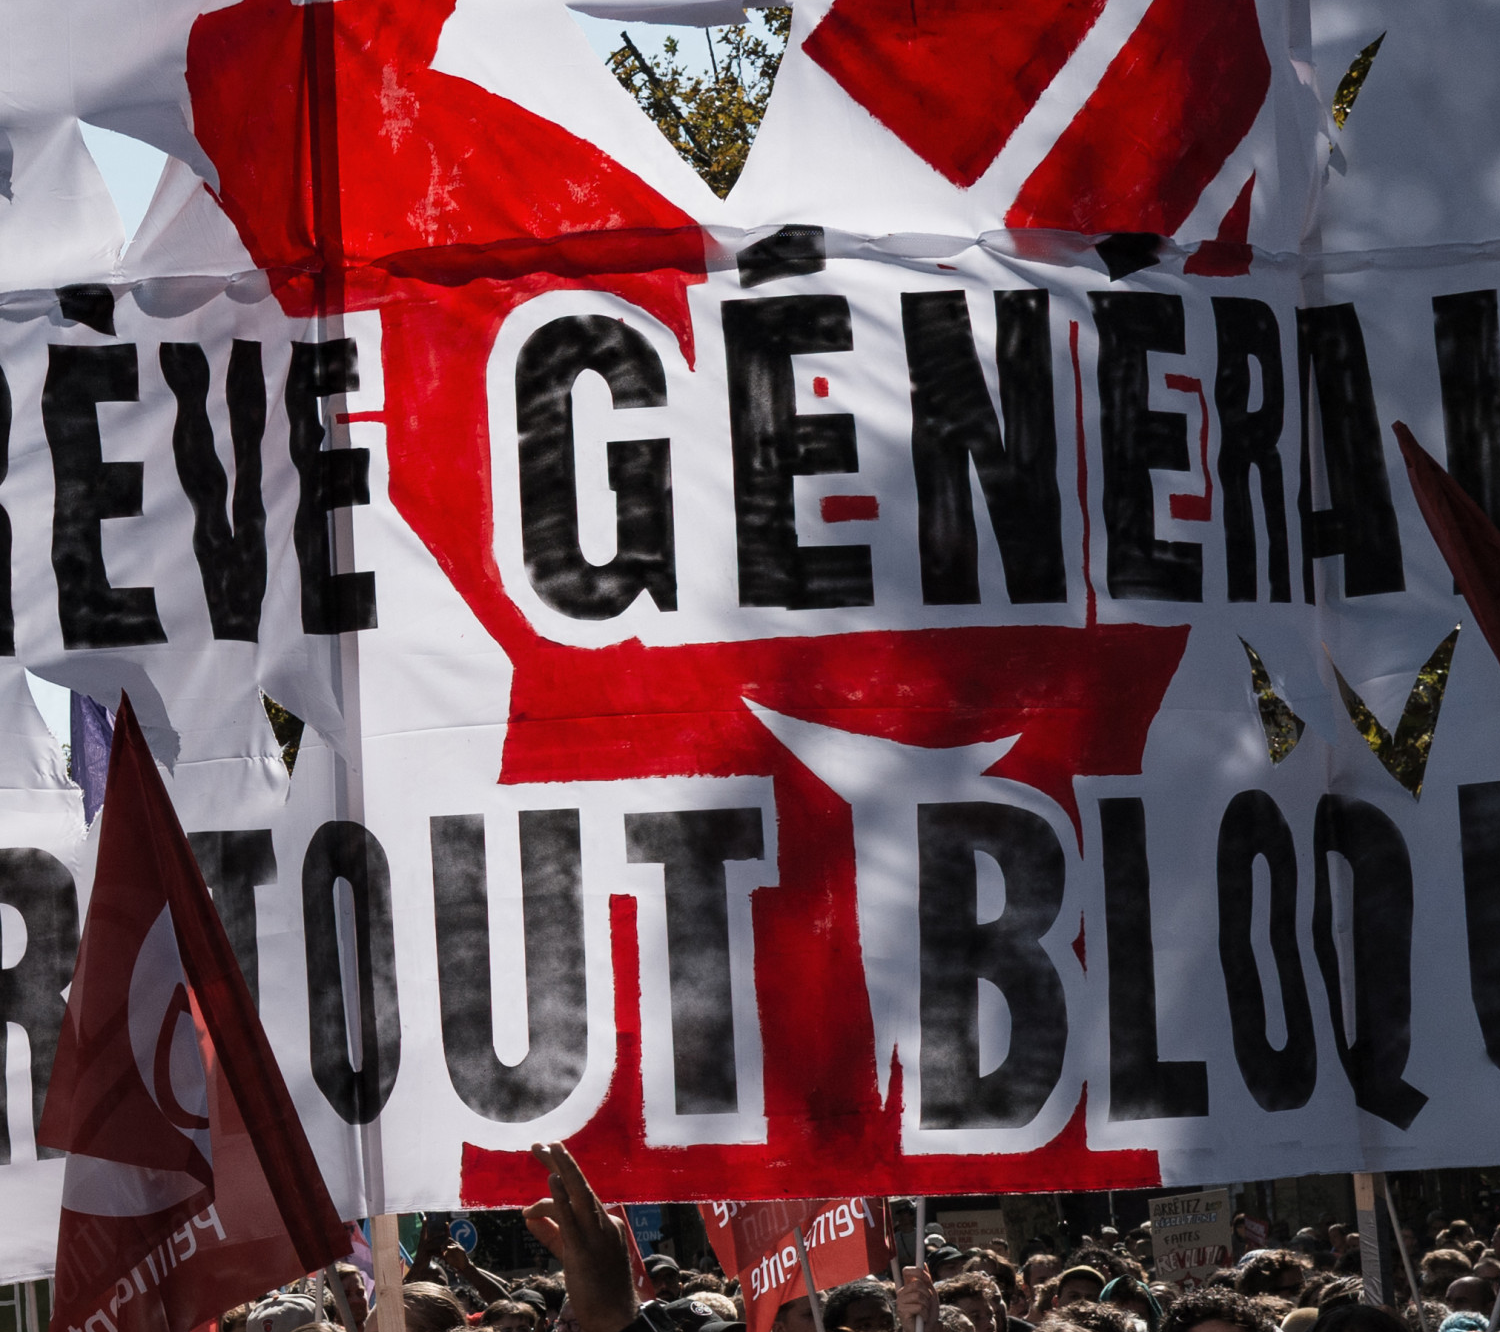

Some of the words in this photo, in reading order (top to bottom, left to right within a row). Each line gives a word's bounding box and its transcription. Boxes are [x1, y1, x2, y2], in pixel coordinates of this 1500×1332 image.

[186, 808, 765, 1125] TOUT
[1154, 1198, 1201, 1217] ARRÊTEZ
[1163, 1230, 1201, 1246] FAITES
